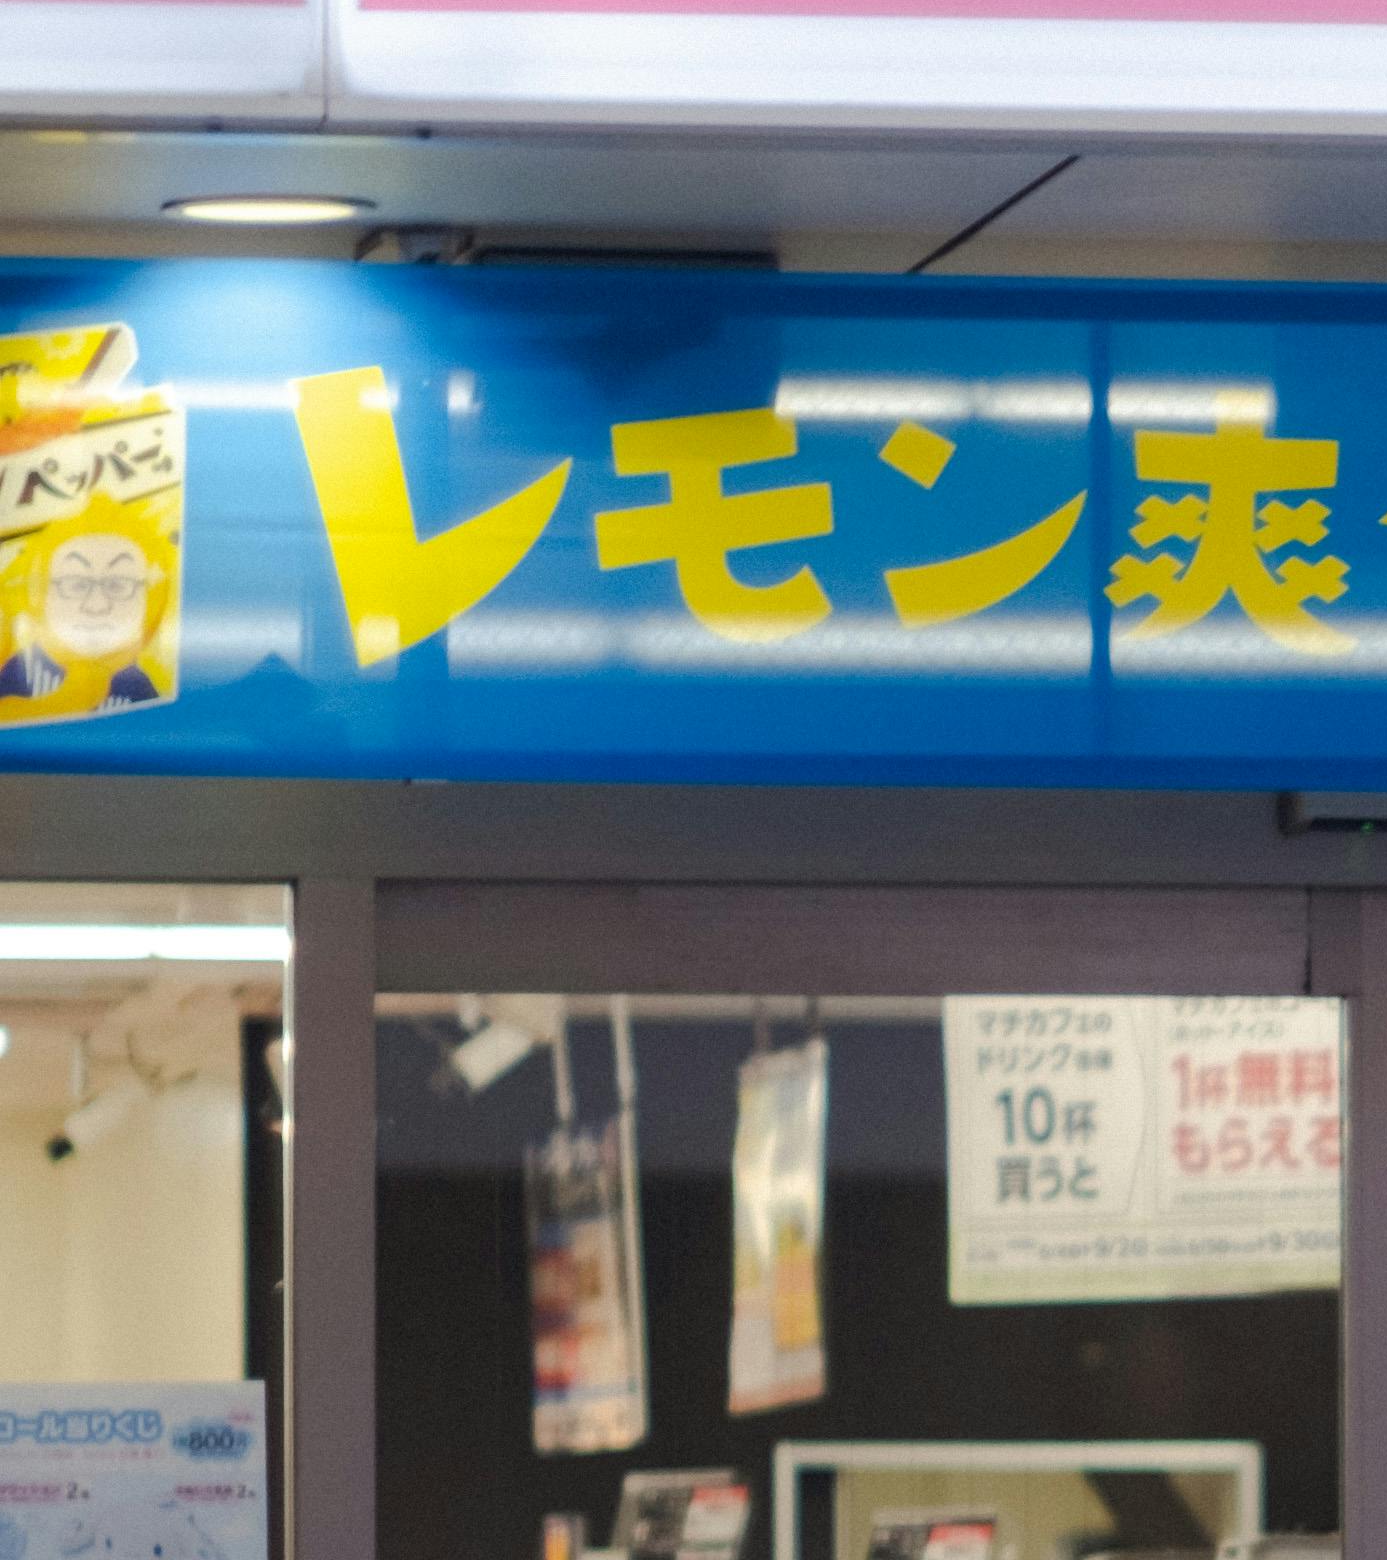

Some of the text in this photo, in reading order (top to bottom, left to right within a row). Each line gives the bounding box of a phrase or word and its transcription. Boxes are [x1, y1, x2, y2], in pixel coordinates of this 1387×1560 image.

[996, 1085, 1097, 1146] 10杯
[996, 1155, 1098, 1203] 買うと
